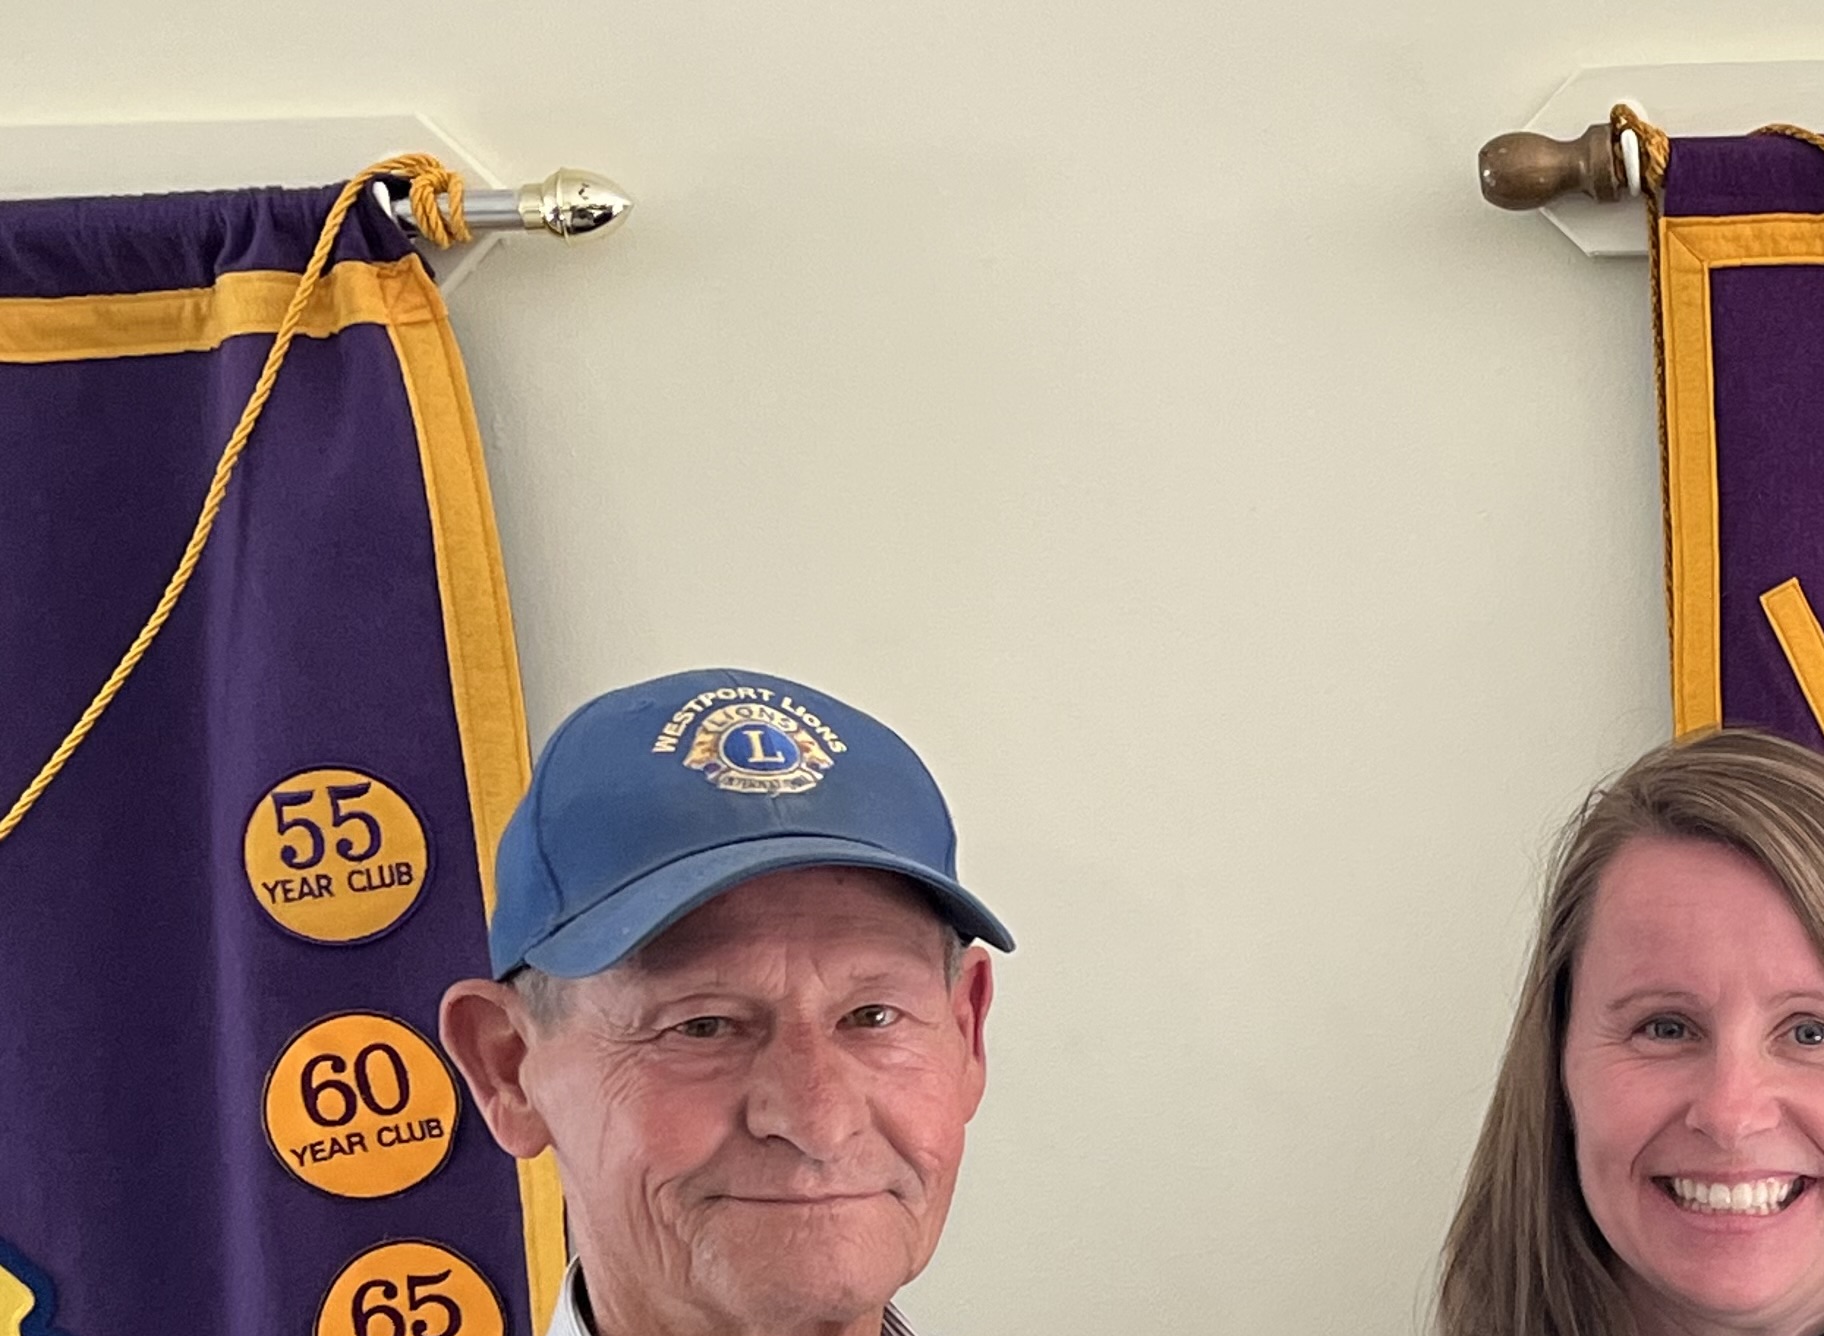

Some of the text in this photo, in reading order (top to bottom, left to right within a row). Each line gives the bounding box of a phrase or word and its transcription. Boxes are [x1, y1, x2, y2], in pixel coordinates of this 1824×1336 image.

[651, 686, 848, 754] WESTPORT LIONS
[713, 705, 795, 731] LIONS
[743, 730, 785, 763] L
[271, 782, 382, 870] 55
[261, 862, 414, 905] YEAR CLUB
[299, 1042, 410, 1128] 60
[289, 1117, 445, 1168] YEAR CLUB
